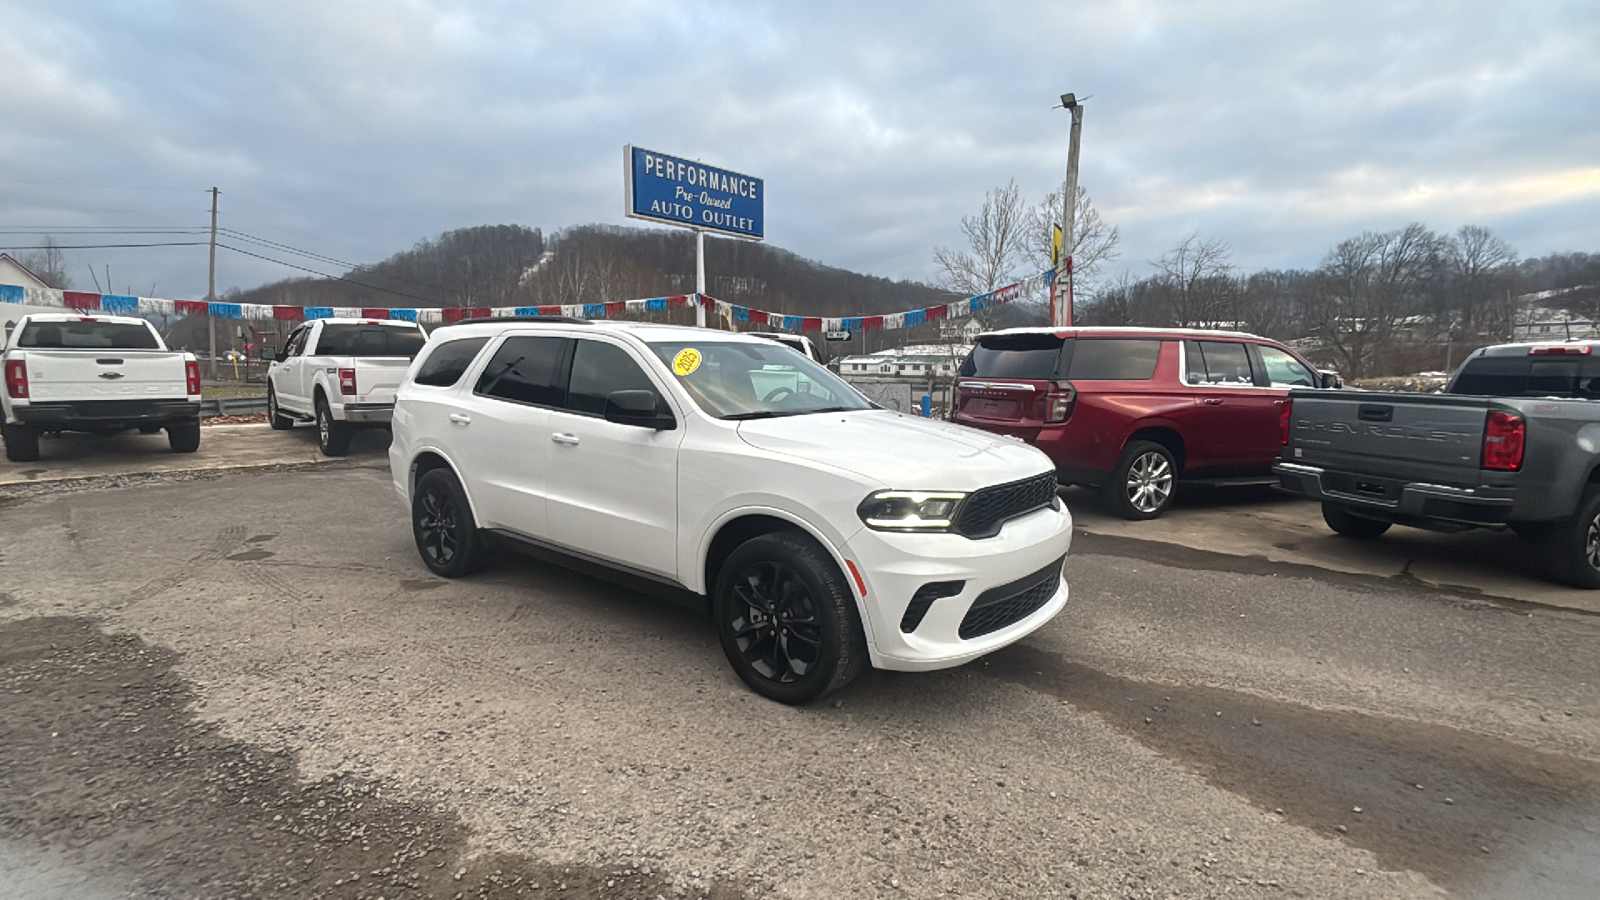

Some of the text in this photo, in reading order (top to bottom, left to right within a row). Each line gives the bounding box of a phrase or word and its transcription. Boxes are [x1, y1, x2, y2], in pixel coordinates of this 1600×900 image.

[645, 154, 757, 199] PERFORMANCE
[675, 186, 733, 209] Pre-Owned
[651, 199, 754, 231] AUTO OUTLET
[677, 351, 698, 371] 2025
